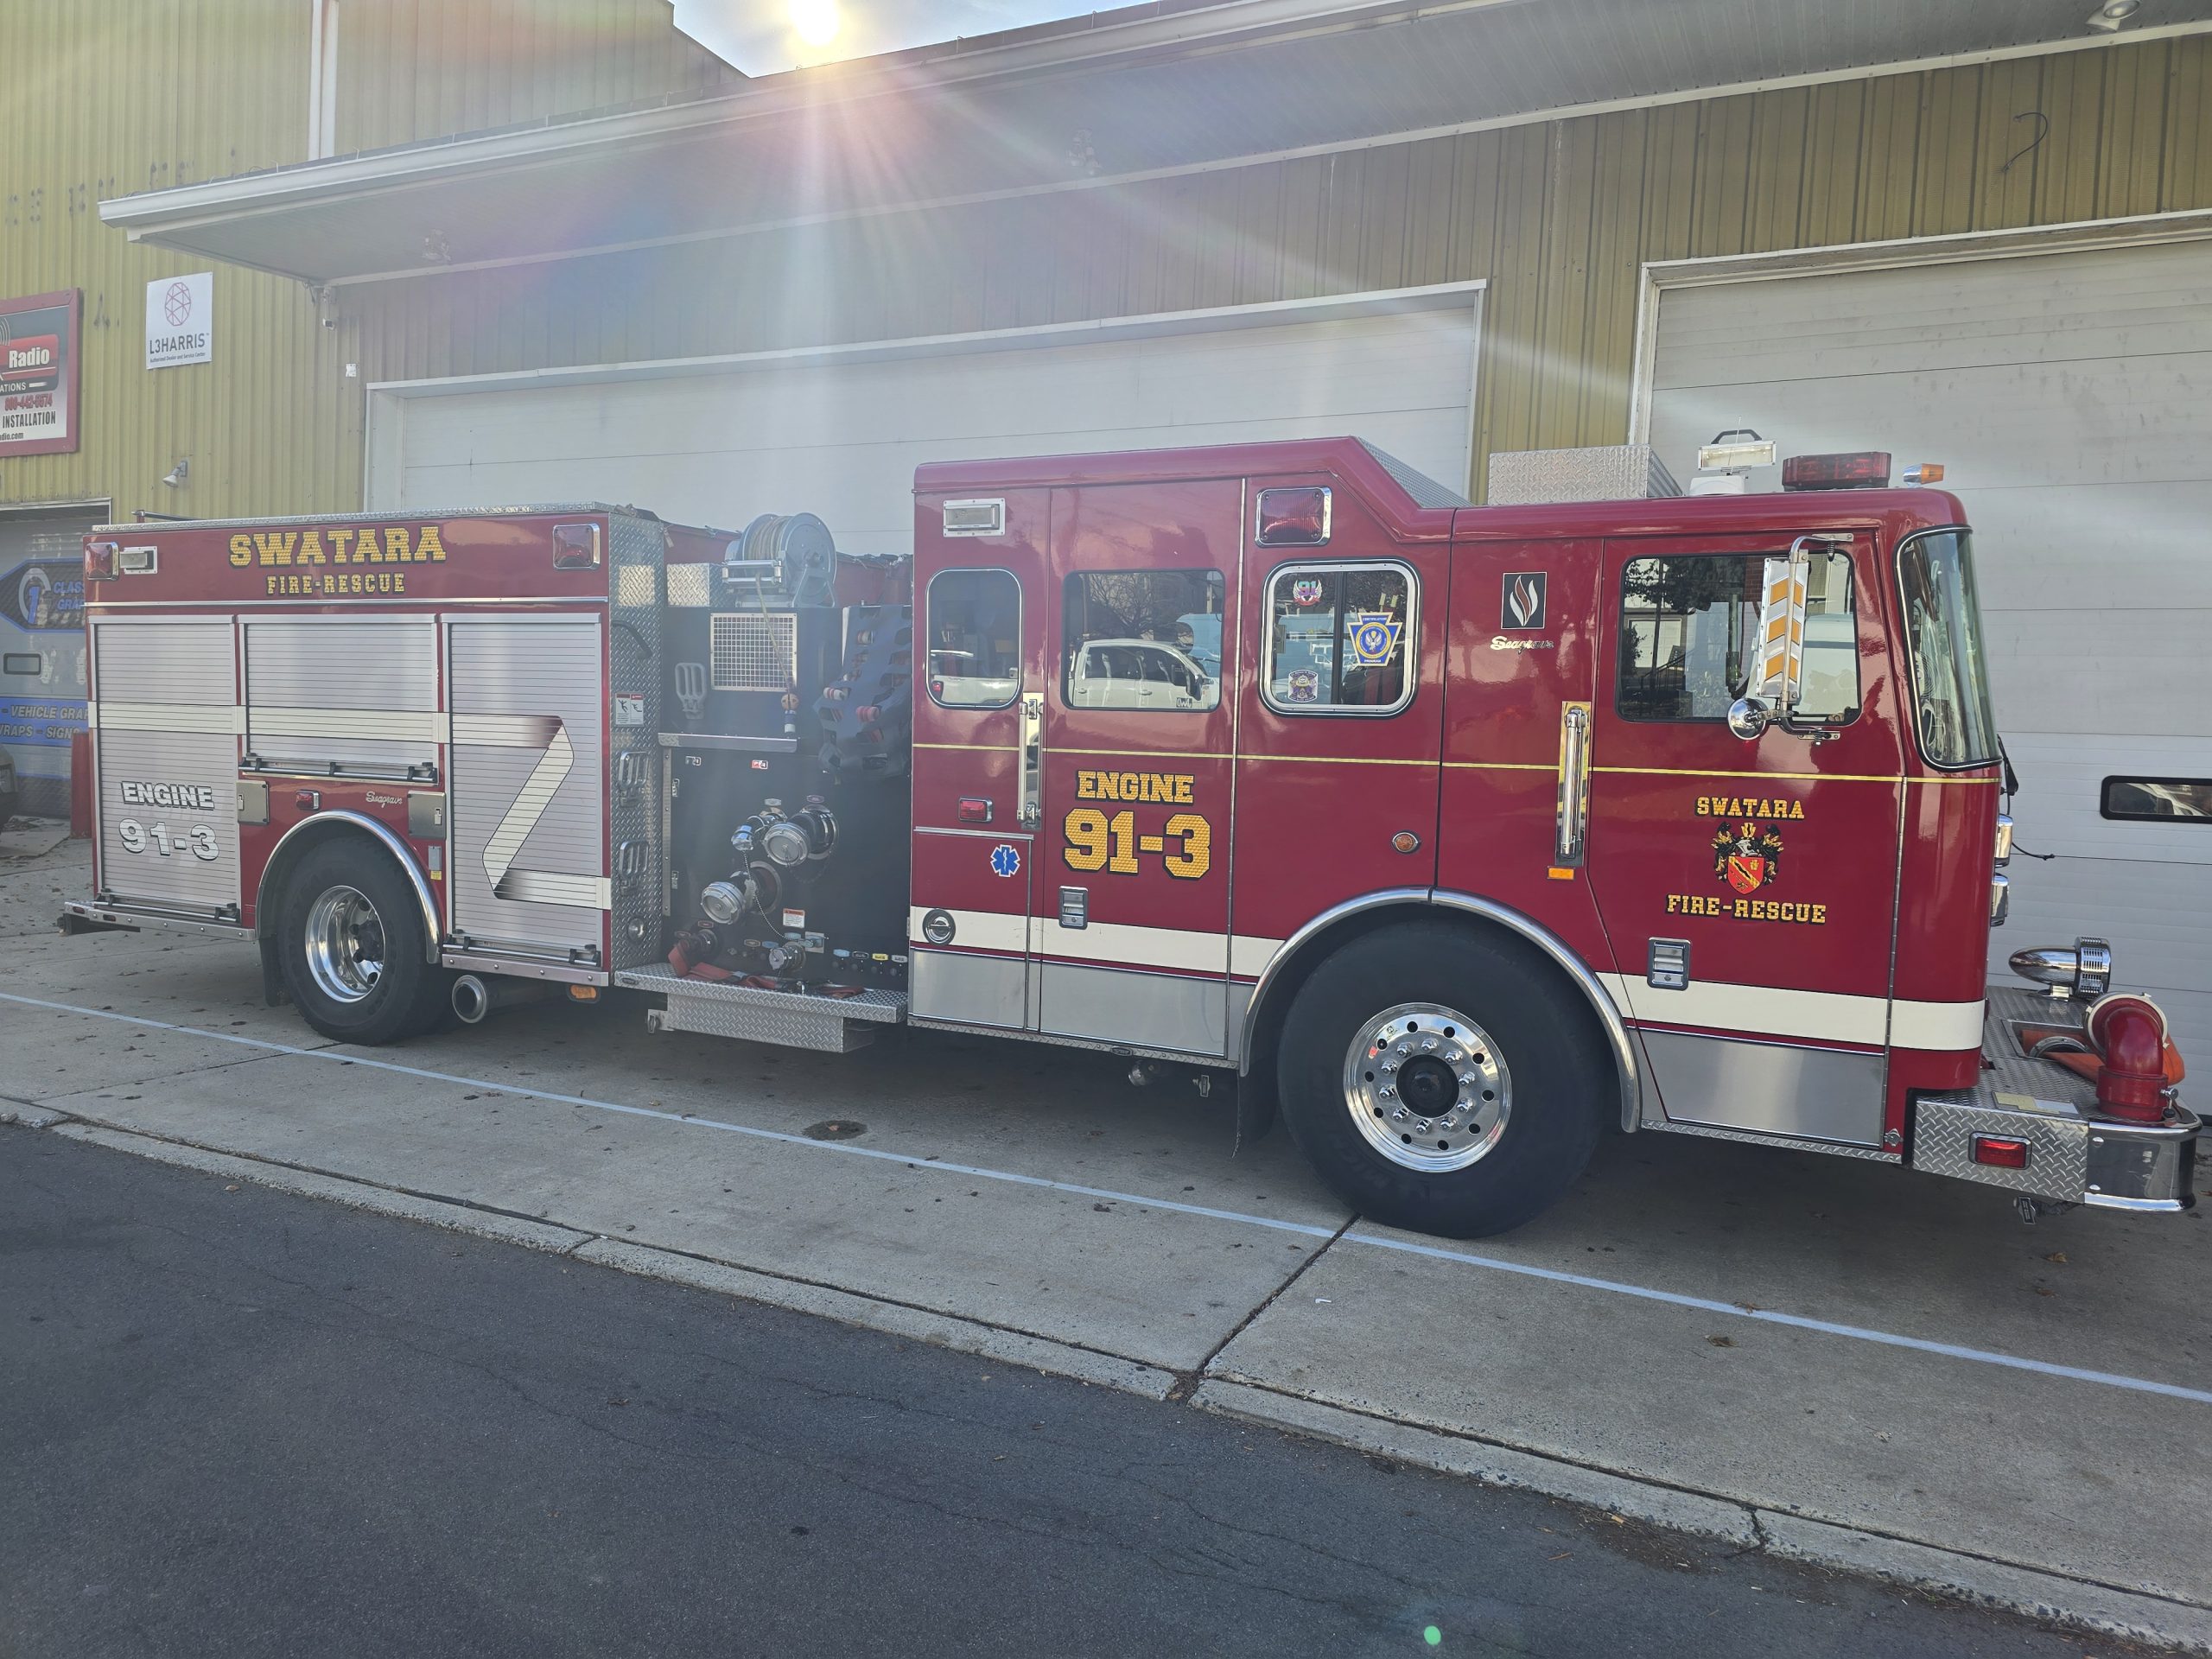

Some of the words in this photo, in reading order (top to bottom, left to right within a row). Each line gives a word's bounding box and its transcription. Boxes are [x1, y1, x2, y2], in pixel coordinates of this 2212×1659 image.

[149, 333, 206, 354] L3HARRIS
[9, 346, 50, 369] Radio
[3, 411, 56, 429] INSTALLATION
[229, 525, 447, 567] SWATARA
[53, 581, 85, 594] CLAS
[265, 572, 406, 595] FIRE-RESCUE
[10, 704, 58, 719] VEHICLE
[120, 780, 215, 810] ENGINE
[1075, 769, 1194, 804] ENGINE
[1694, 796, 1805, 821] SWATARA
[118, 817, 220, 861] 91-3
[1062, 807, 1211, 880] 91-3
[1665, 893, 1827, 925] FIRE-RESCUE
